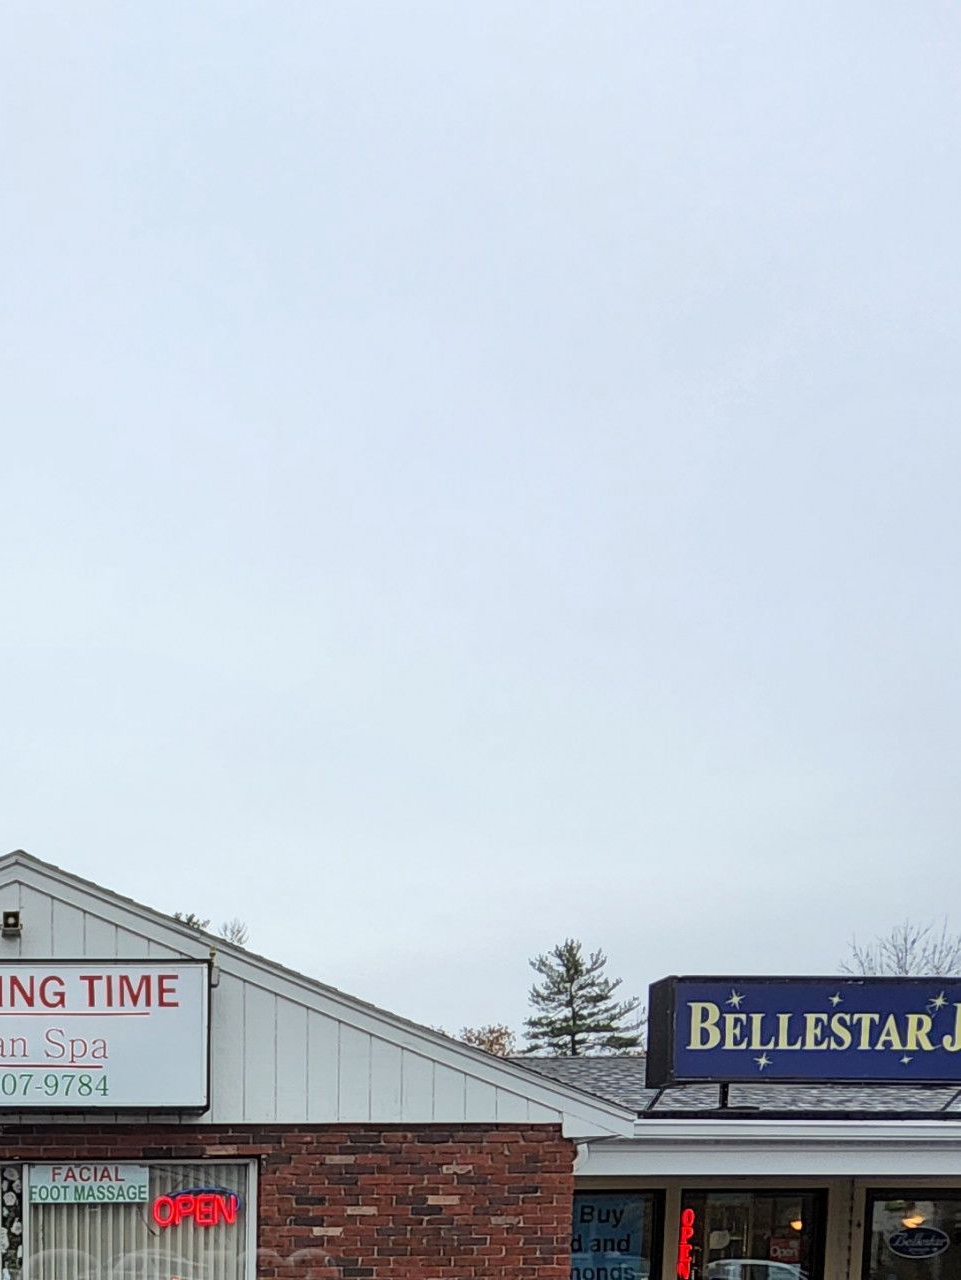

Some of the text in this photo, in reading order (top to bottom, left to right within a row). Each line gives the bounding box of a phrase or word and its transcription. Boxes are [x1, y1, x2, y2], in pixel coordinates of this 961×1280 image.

[79, 974, 179, 1008] TIME
[686, 1001, 935, 1051] BELLESTAR
[44, 1028, 109, 1063] Spa
[52, 1166, 125, 1182] FACIAL
[30, 1184, 148, 1201] FOOT MASSAGE
[153, 1194, 237, 1227] OPEN
[580, 1205, 624, 1227] Buy
[590, 1234, 630, 1252] and
[678, 1209, 695, 1280] OPEN
